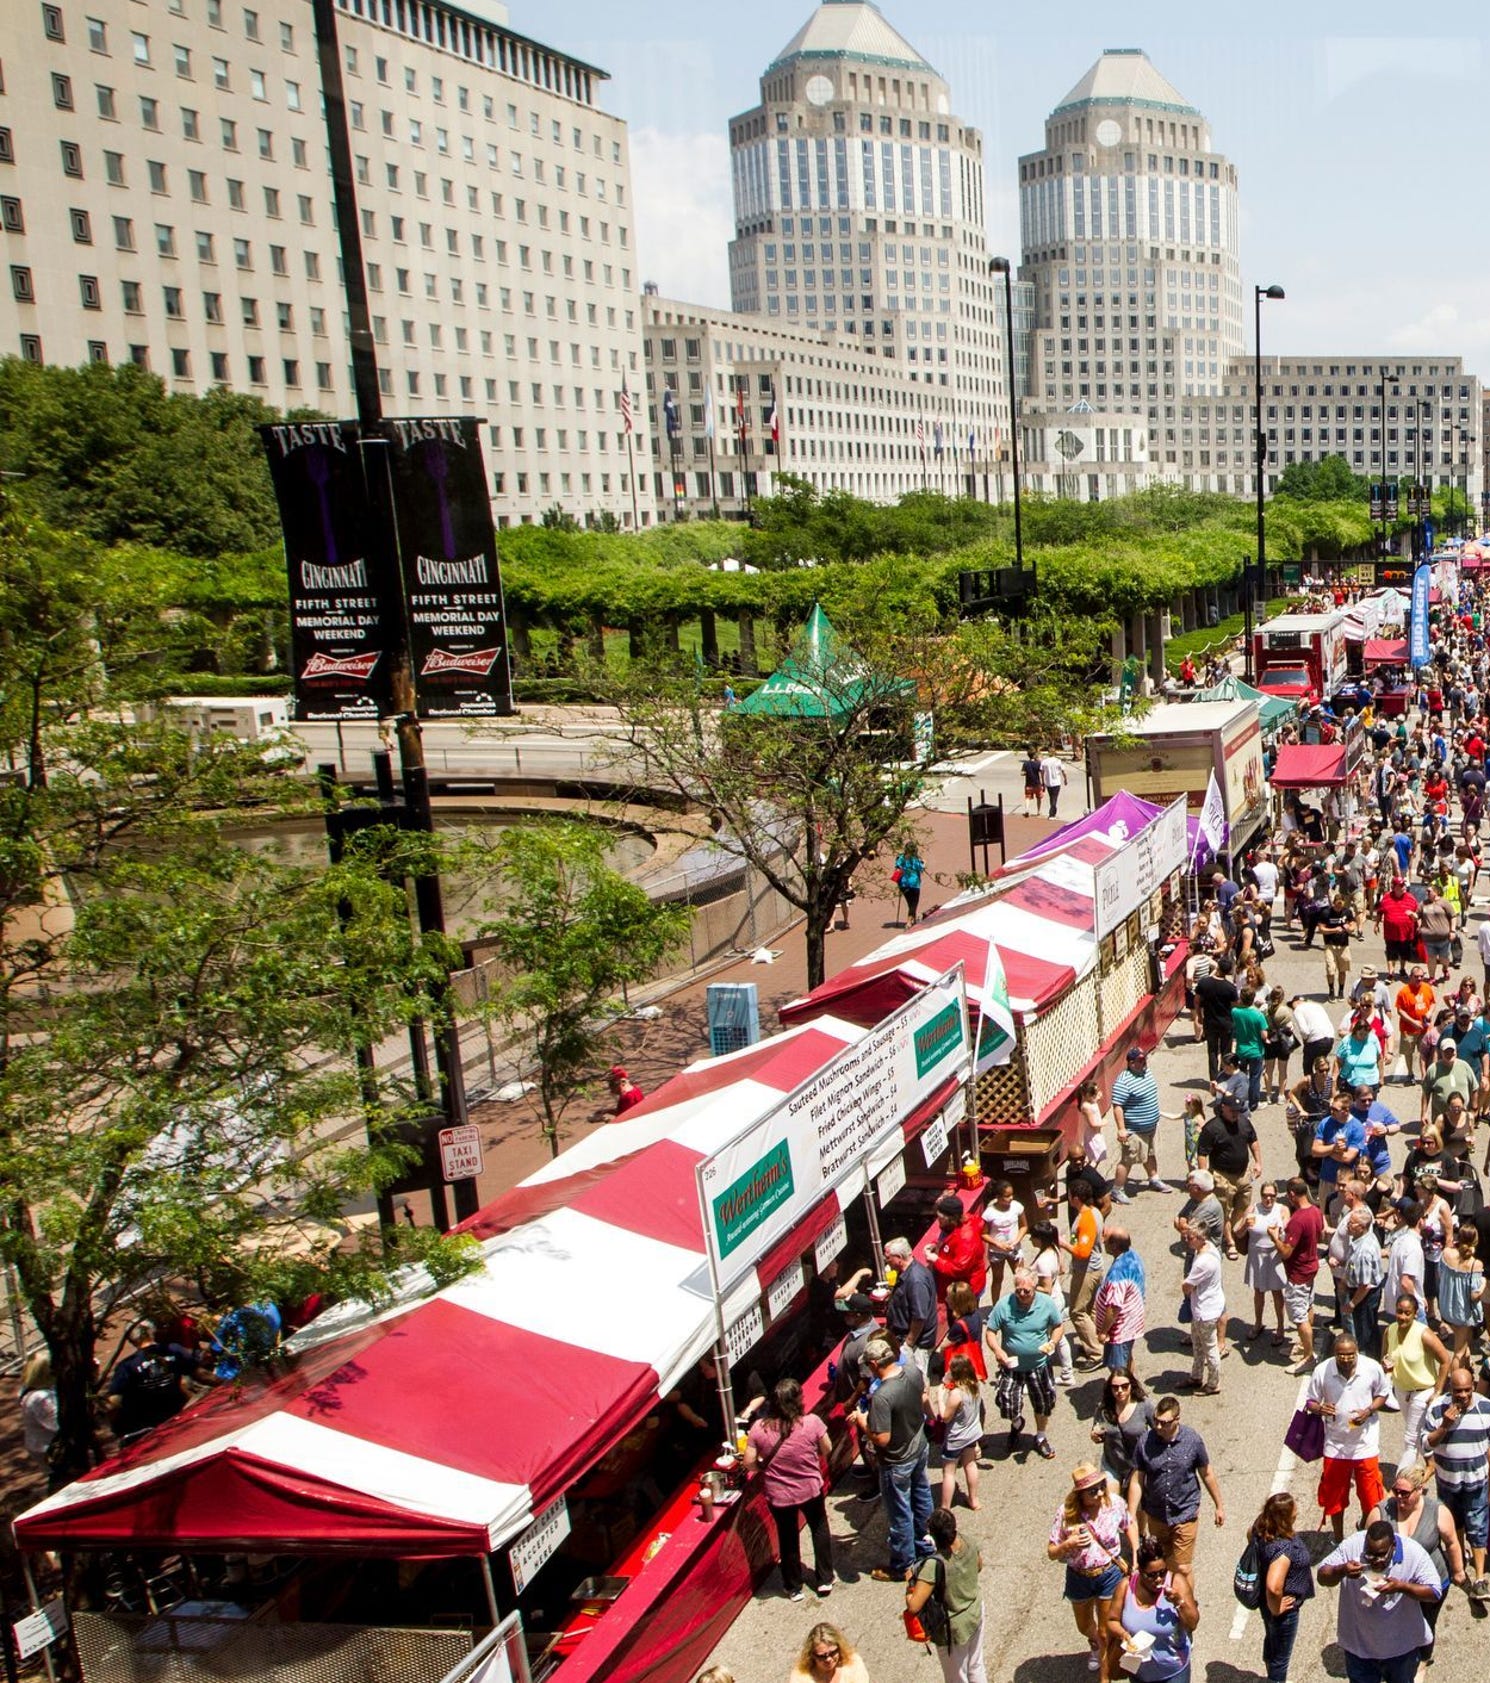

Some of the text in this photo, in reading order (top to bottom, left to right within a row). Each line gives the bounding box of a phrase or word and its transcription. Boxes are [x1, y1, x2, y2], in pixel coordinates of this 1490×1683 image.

[272, 422, 347, 458] TASTE
[393, 418, 467, 451] TASTE
[301, 558, 368, 589] CINCINNATI
[417, 553, 488, 585] CINCINNATI
[295, 597, 377, 610] FIFTH STREET
[411, 594, 497, 605] FIFTH STREET
[1415, 577, 1425, 623] LIGHT
[296, 615, 380, 627] MEMORIAL DAY
[413, 611, 500, 623] MEMORIAL DAY
[431, 625, 486, 636] WEEKEND
[313, 629, 366, 640] WEEKEND
[307, 658, 373, 673] Budweiser
[426, 654, 493, 668] Budweiser
[788, 1086, 817, 1117] Sauteed
[818, 1055, 860, 1093] Mushrooms
[861, 1047, 873, 1063] and
[872, 1029, 896, 1051] Sausage
[810, 1099, 827, 1122] Filet
[827, 1082, 853, 1109] Mignon
[854, 1057, 884, 1087] Sandwich
[818, 1116, 836, 1138] Fried
[836, 1098, 862, 1125] Chicken
[863, 1078, 882, 1101] Wings
[819, 1121, 855, 1161] Mettwurst
[856, 1097, 885, 1127] Sandwich
[449, 1157, 478, 1170] STAND
[452, 1145, 472, 1157] TAXI
[821, 1140, 857, 1180] Bratwurst
[857, 1116, 885, 1148] Sandwich
[719, 1149, 788, 1227] Wertheim's
[512, 1496, 564, 1560] CREDIT CARDS
[523, 1520, 559, 1565] ACCEPTED
[534, 1544, 553, 1571] HERE
